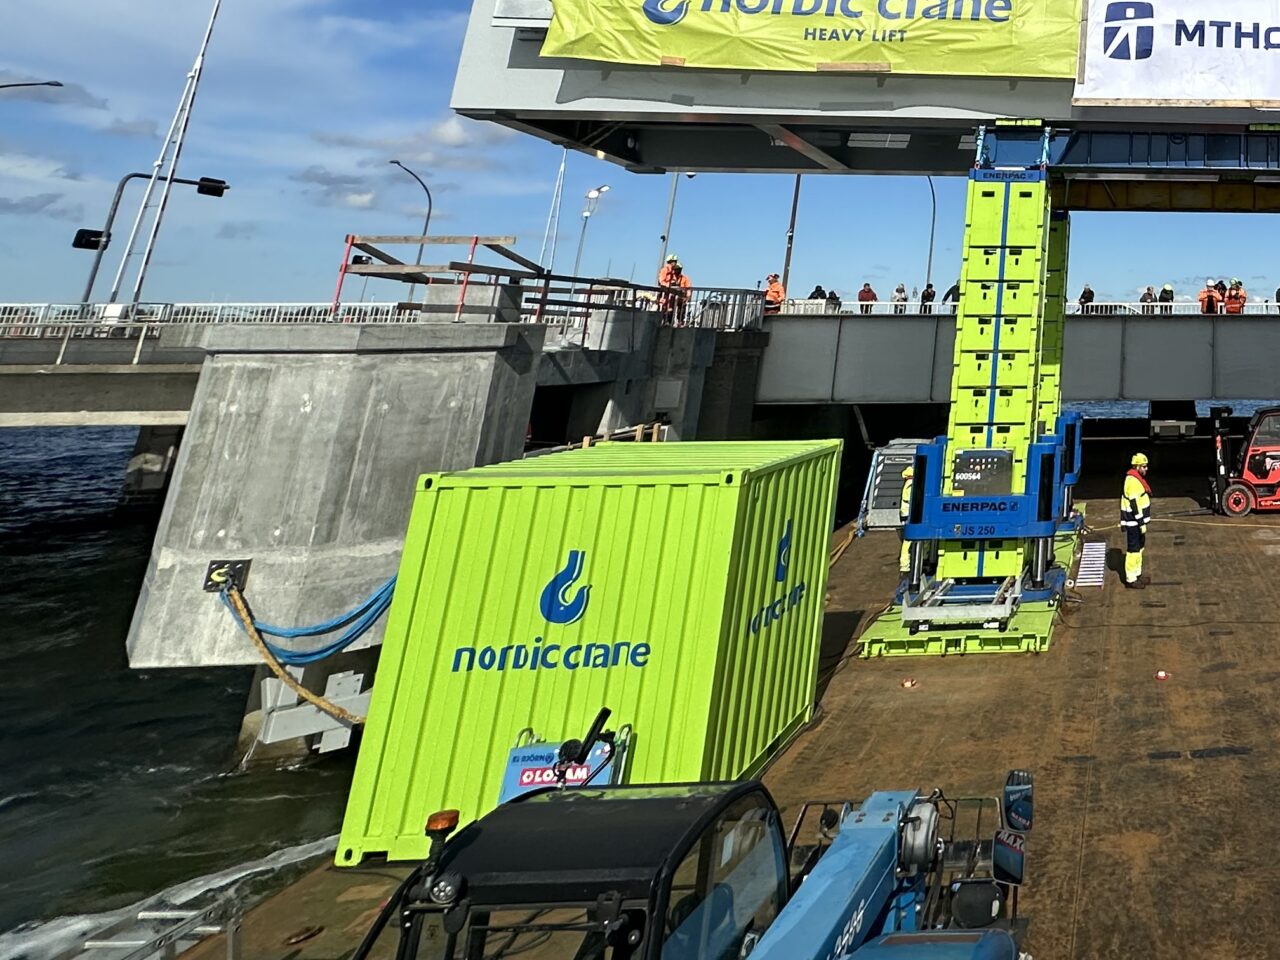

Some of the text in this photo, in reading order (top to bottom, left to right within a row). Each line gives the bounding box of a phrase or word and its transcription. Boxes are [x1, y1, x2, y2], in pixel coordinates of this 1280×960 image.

[804, 27, 907, 43] HEAVY LIFT
[955, 472, 981, 480] 600564
[942, 502, 1008, 512] ENERPAC
[962, 526, 996, 536] JS 250
[533, 766, 588, 782] LOAM
